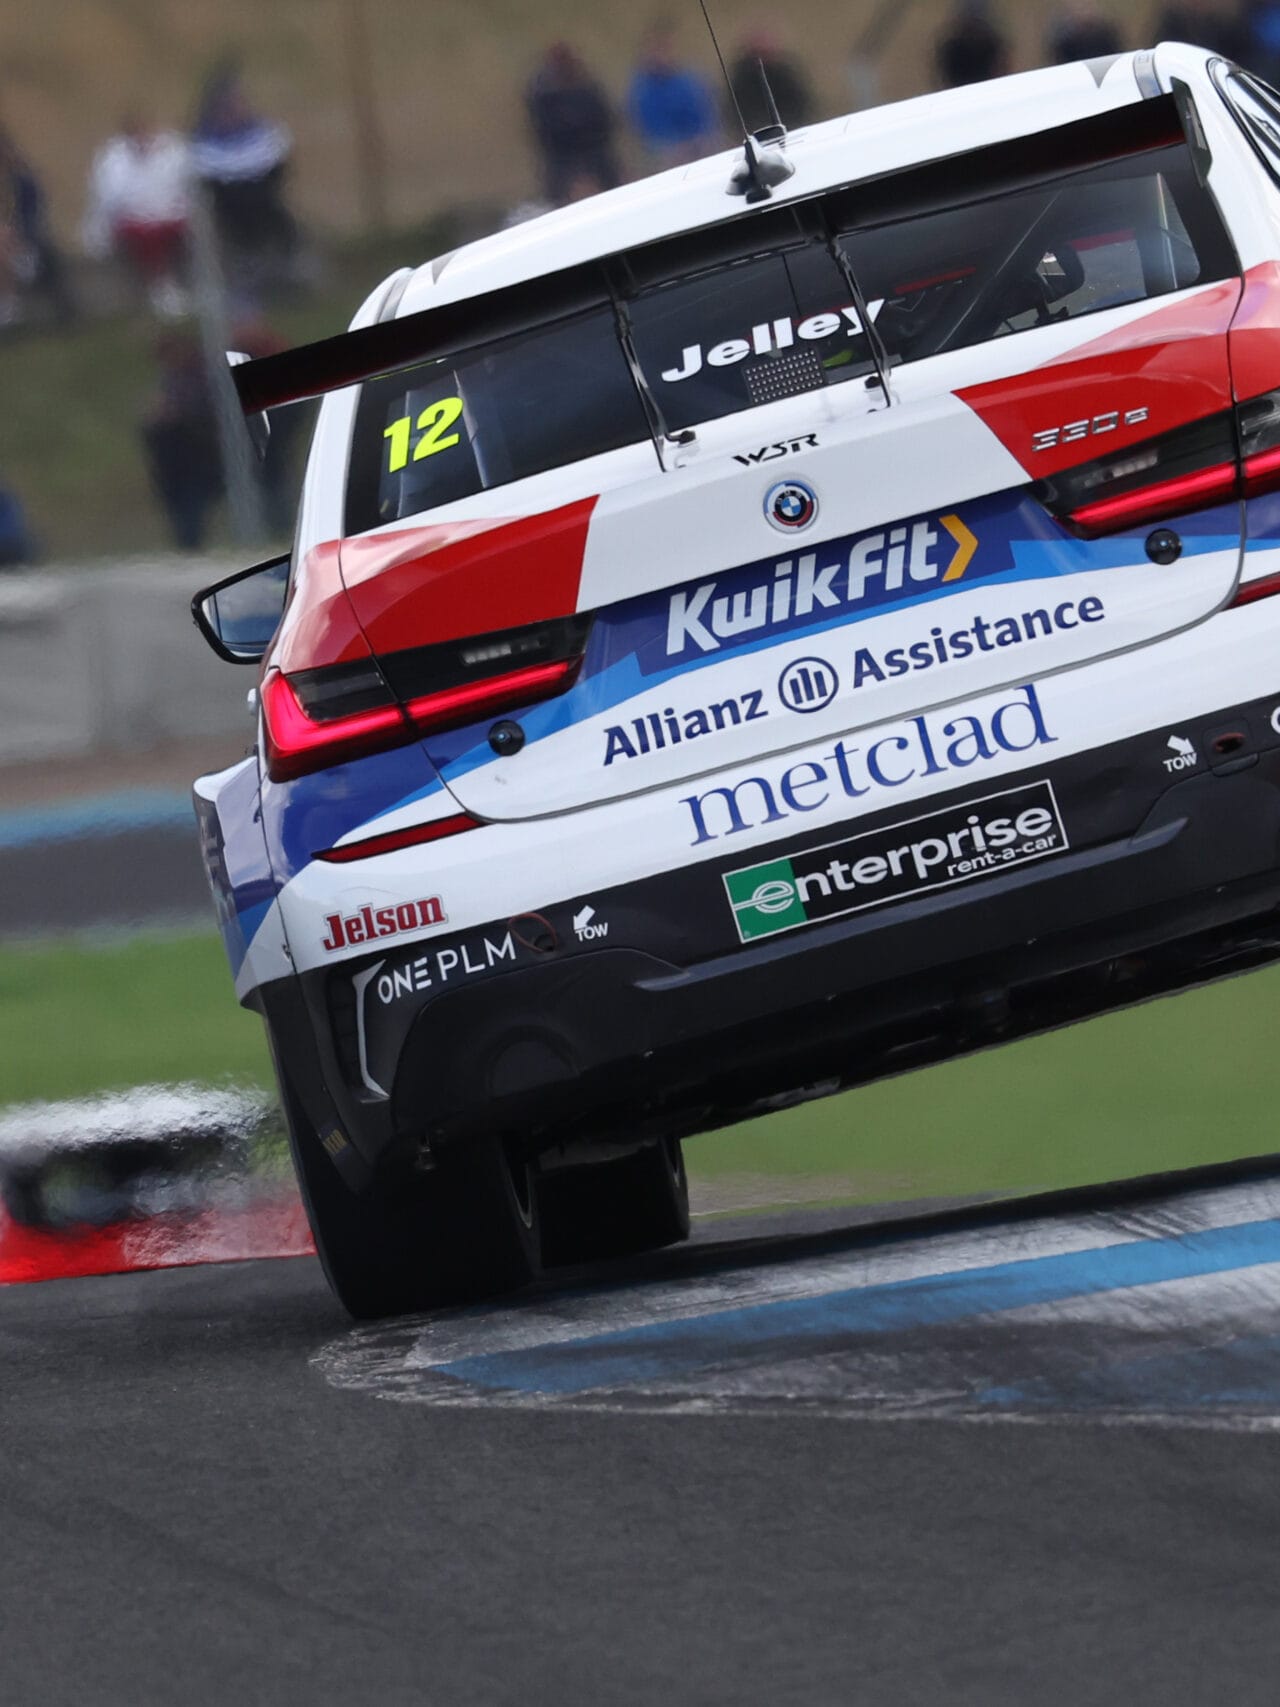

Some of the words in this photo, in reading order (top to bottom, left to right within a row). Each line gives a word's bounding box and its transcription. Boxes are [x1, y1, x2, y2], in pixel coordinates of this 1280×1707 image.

[661, 299, 884, 382] Jelley
[383, 397, 464, 473] 12
[731, 433, 819, 466] WSR
[603, 690, 768, 766] Allianz
[852, 597, 1105, 688] Assistance
[679, 684, 1058, 846] metclad
[1163, 752, 1197, 772] TOW
[750, 802, 1053, 914] enterprise
[947, 834, 1057, 877] rent-a-car
[322, 896, 447, 951] Jelson
[576, 923, 608, 941] TOW
[378, 957, 432, 1003] ONE
[436, 931, 517, 980] PLM
